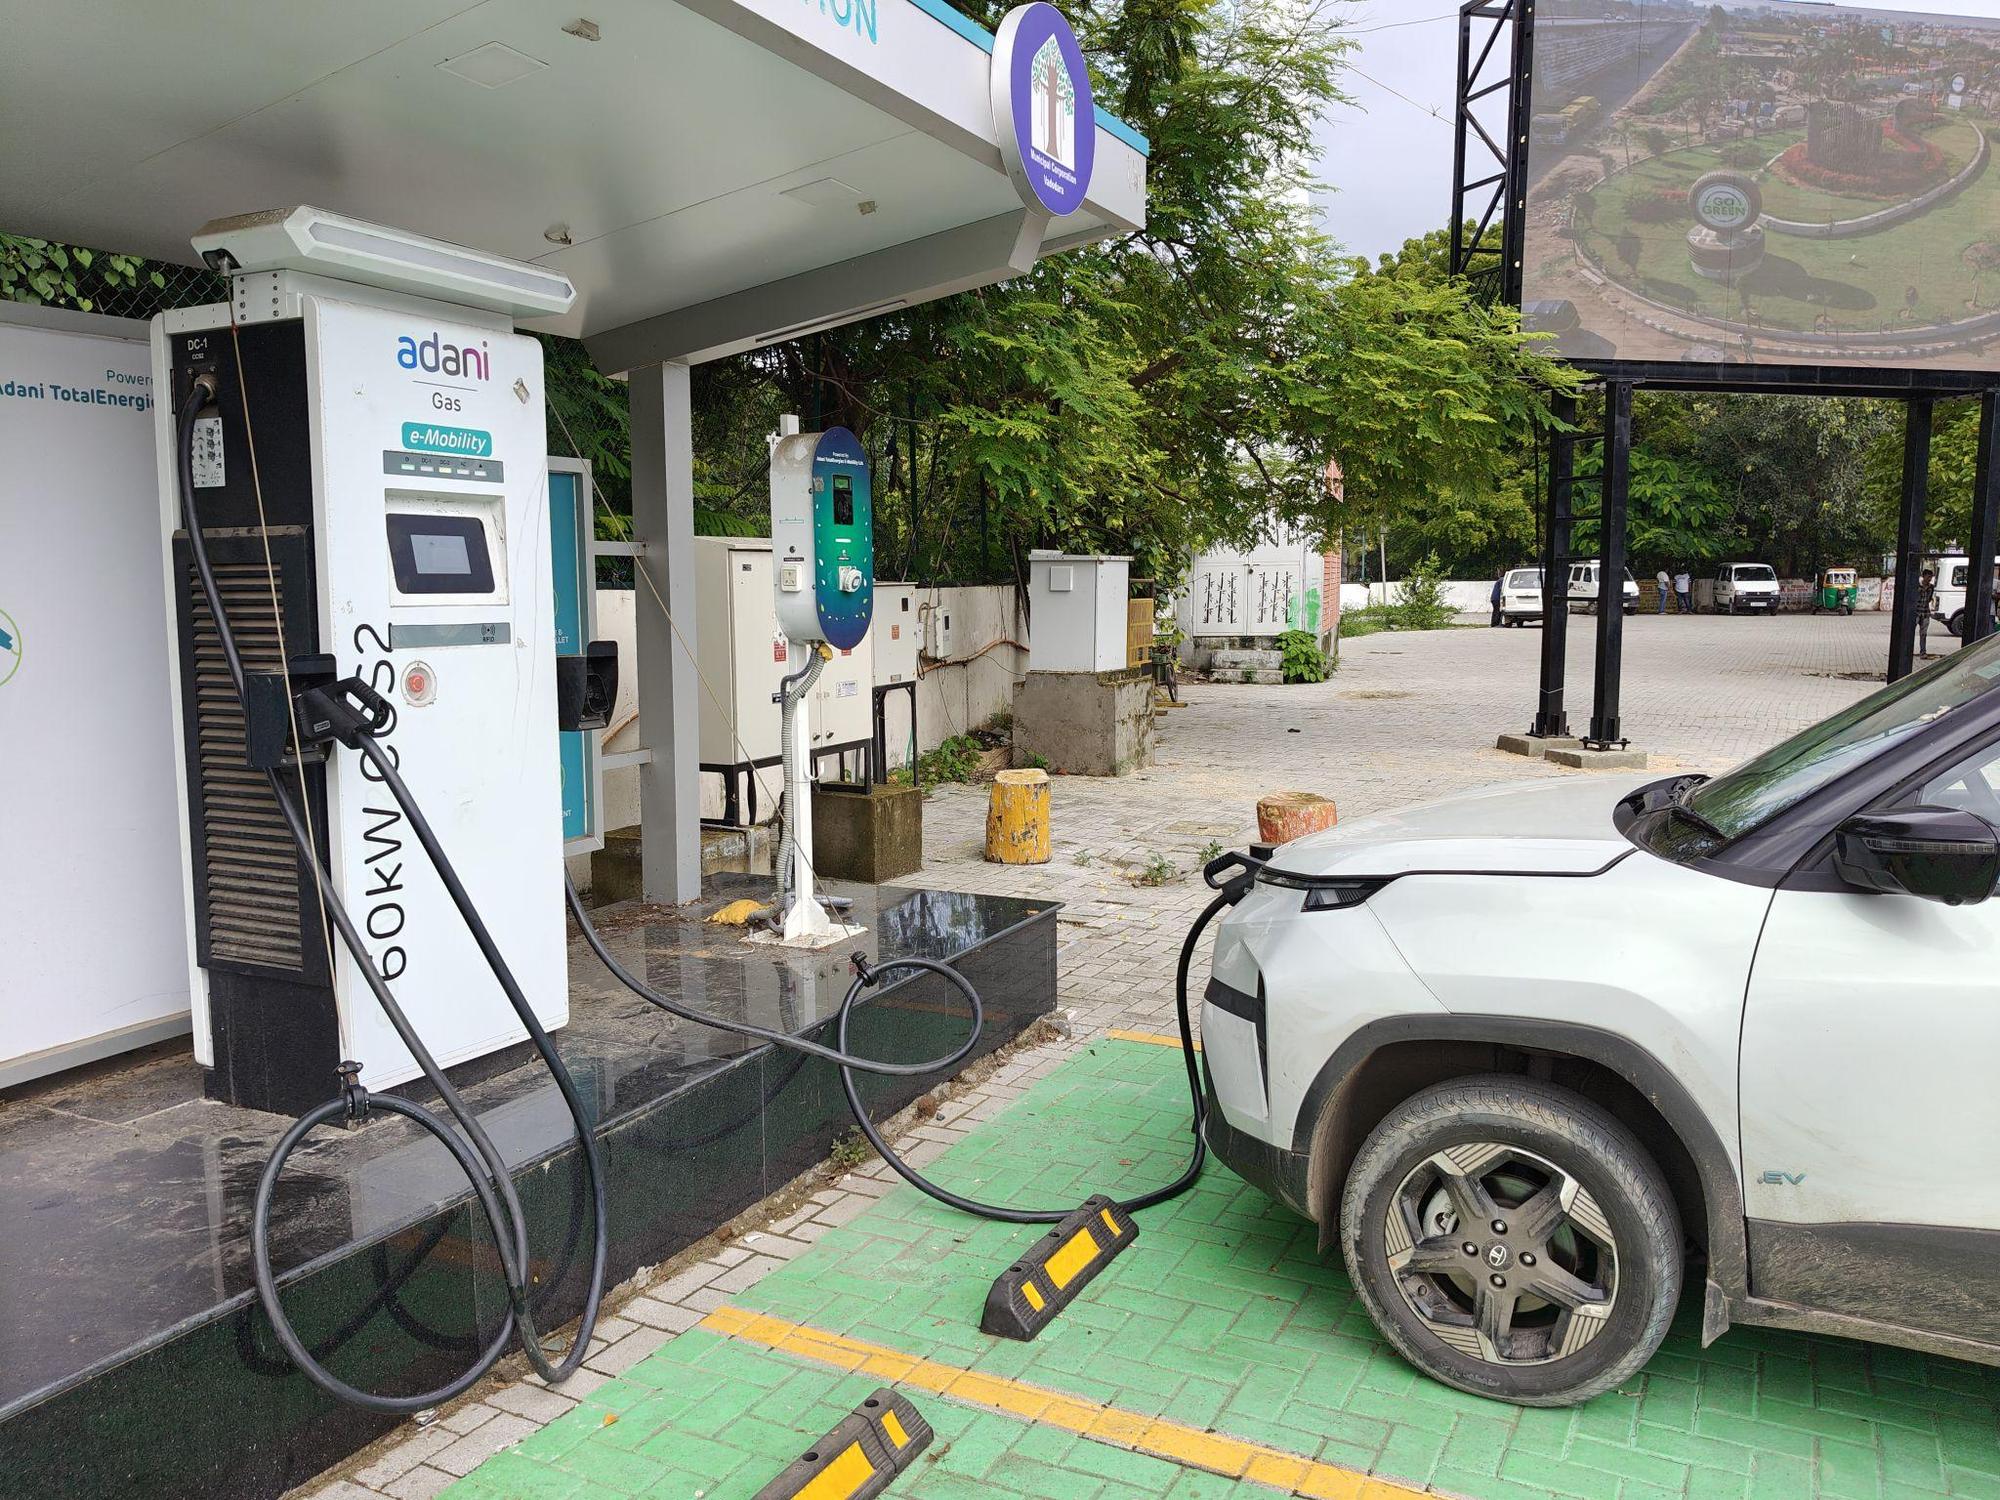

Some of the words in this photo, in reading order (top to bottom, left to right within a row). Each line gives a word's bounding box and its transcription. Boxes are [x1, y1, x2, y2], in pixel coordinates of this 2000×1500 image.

[1030, 147, 1051, 171] Municipal
[1051, 162, 1077, 185] Corporation
[1043, 173, 1065, 196] Vadodara
[1702, 205, 1746, 217] GREEN
[1712, 196, 1735, 207] GO
[187, 337, 208, 351] DC-1
[397, 331, 491, 382] adani
[431, 391, 462, 413] Gas
[409, 428, 487, 455] e-Mobility
